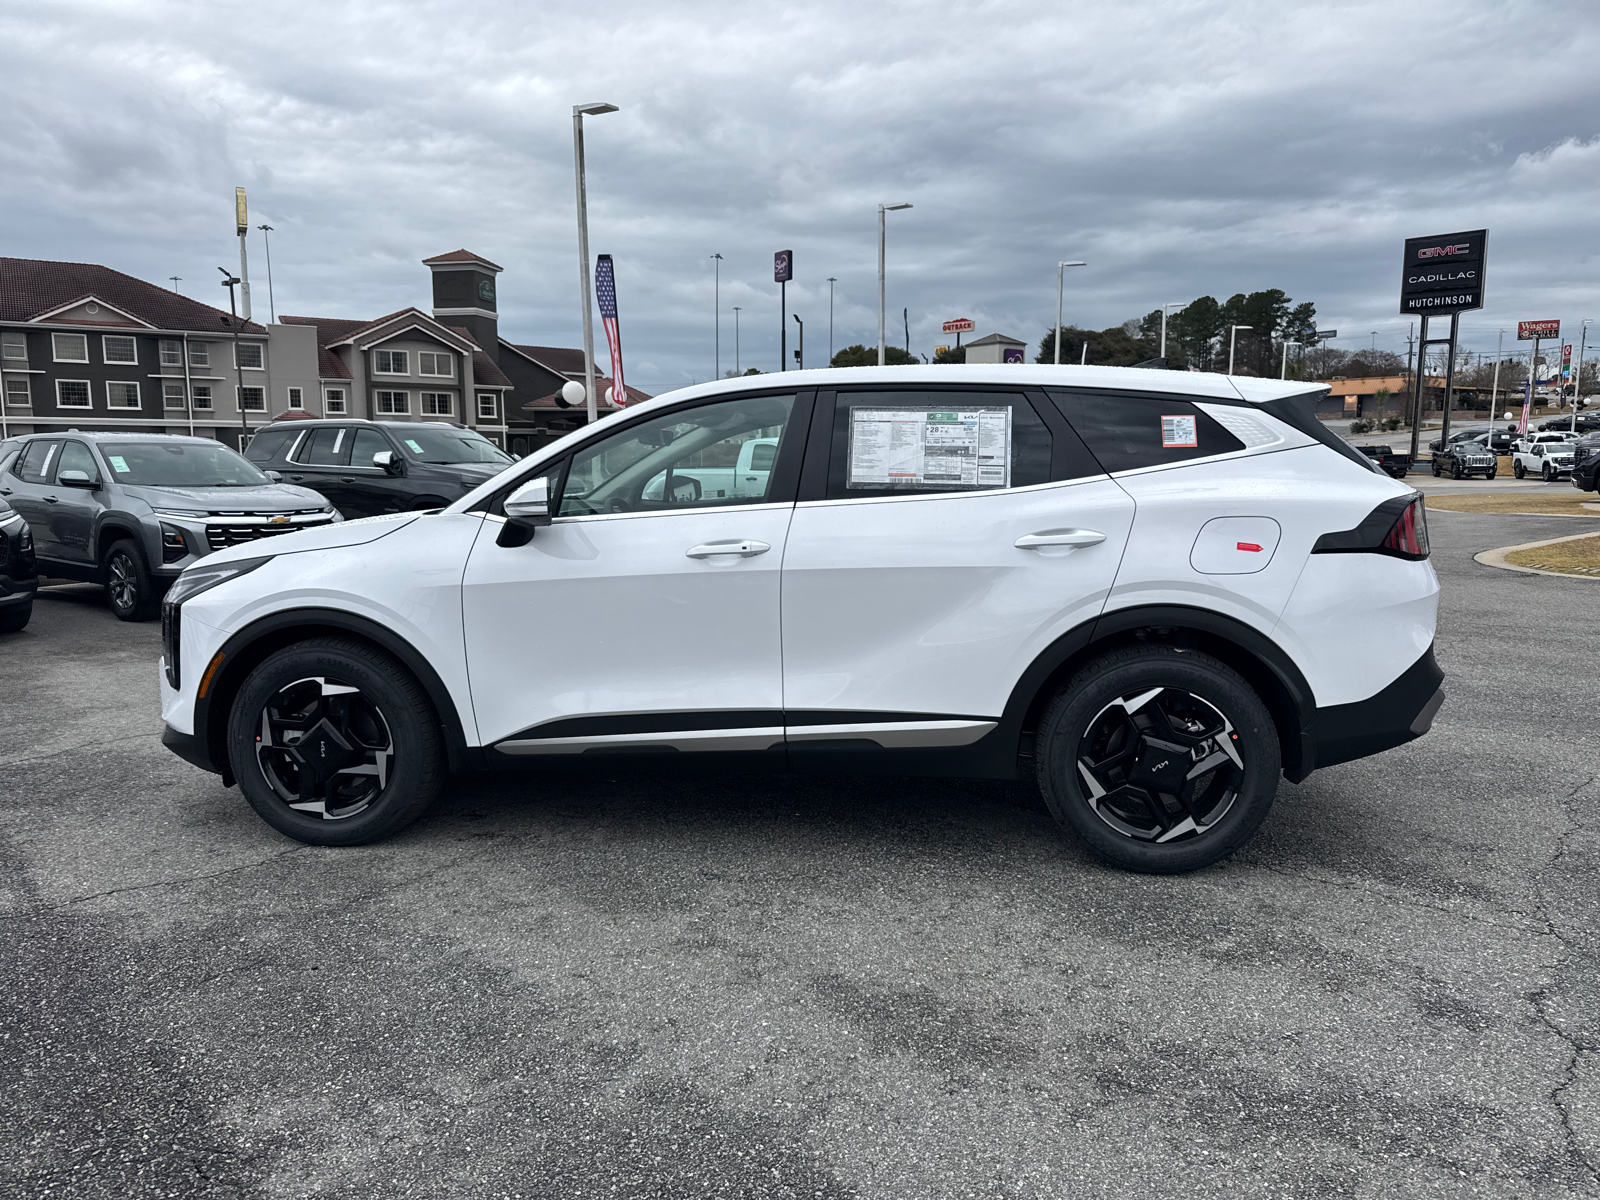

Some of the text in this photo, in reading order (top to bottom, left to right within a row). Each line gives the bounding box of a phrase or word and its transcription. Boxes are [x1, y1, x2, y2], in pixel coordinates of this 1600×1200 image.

[1418, 243, 1470, 259] GMC
[1408, 270, 1476, 284] CADILLAC
[1409, 294, 1473, 308] HUTCHINSON
[942, 322, 972, 331] OUTBACK
[1520, 322, 1558, 331] Wagers
[317, 656, 370, 680] KUMHO
